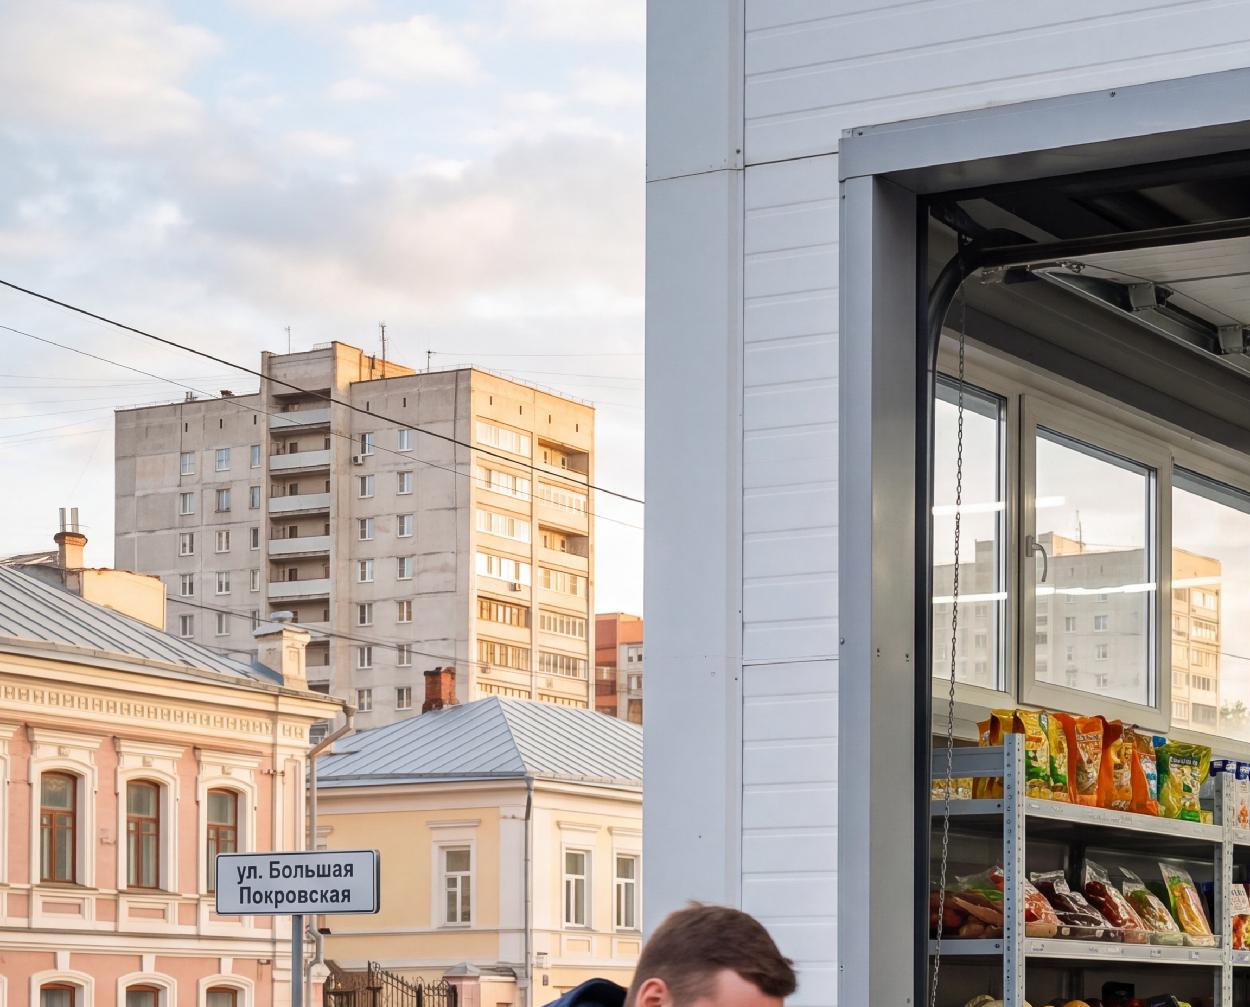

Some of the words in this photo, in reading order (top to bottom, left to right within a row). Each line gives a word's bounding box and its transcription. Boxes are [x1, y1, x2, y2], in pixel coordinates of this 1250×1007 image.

[237, 865, 263, 885] ул.
[269, 860, 354, 879] Большая
[239, 886, 351, 909] Покровская
